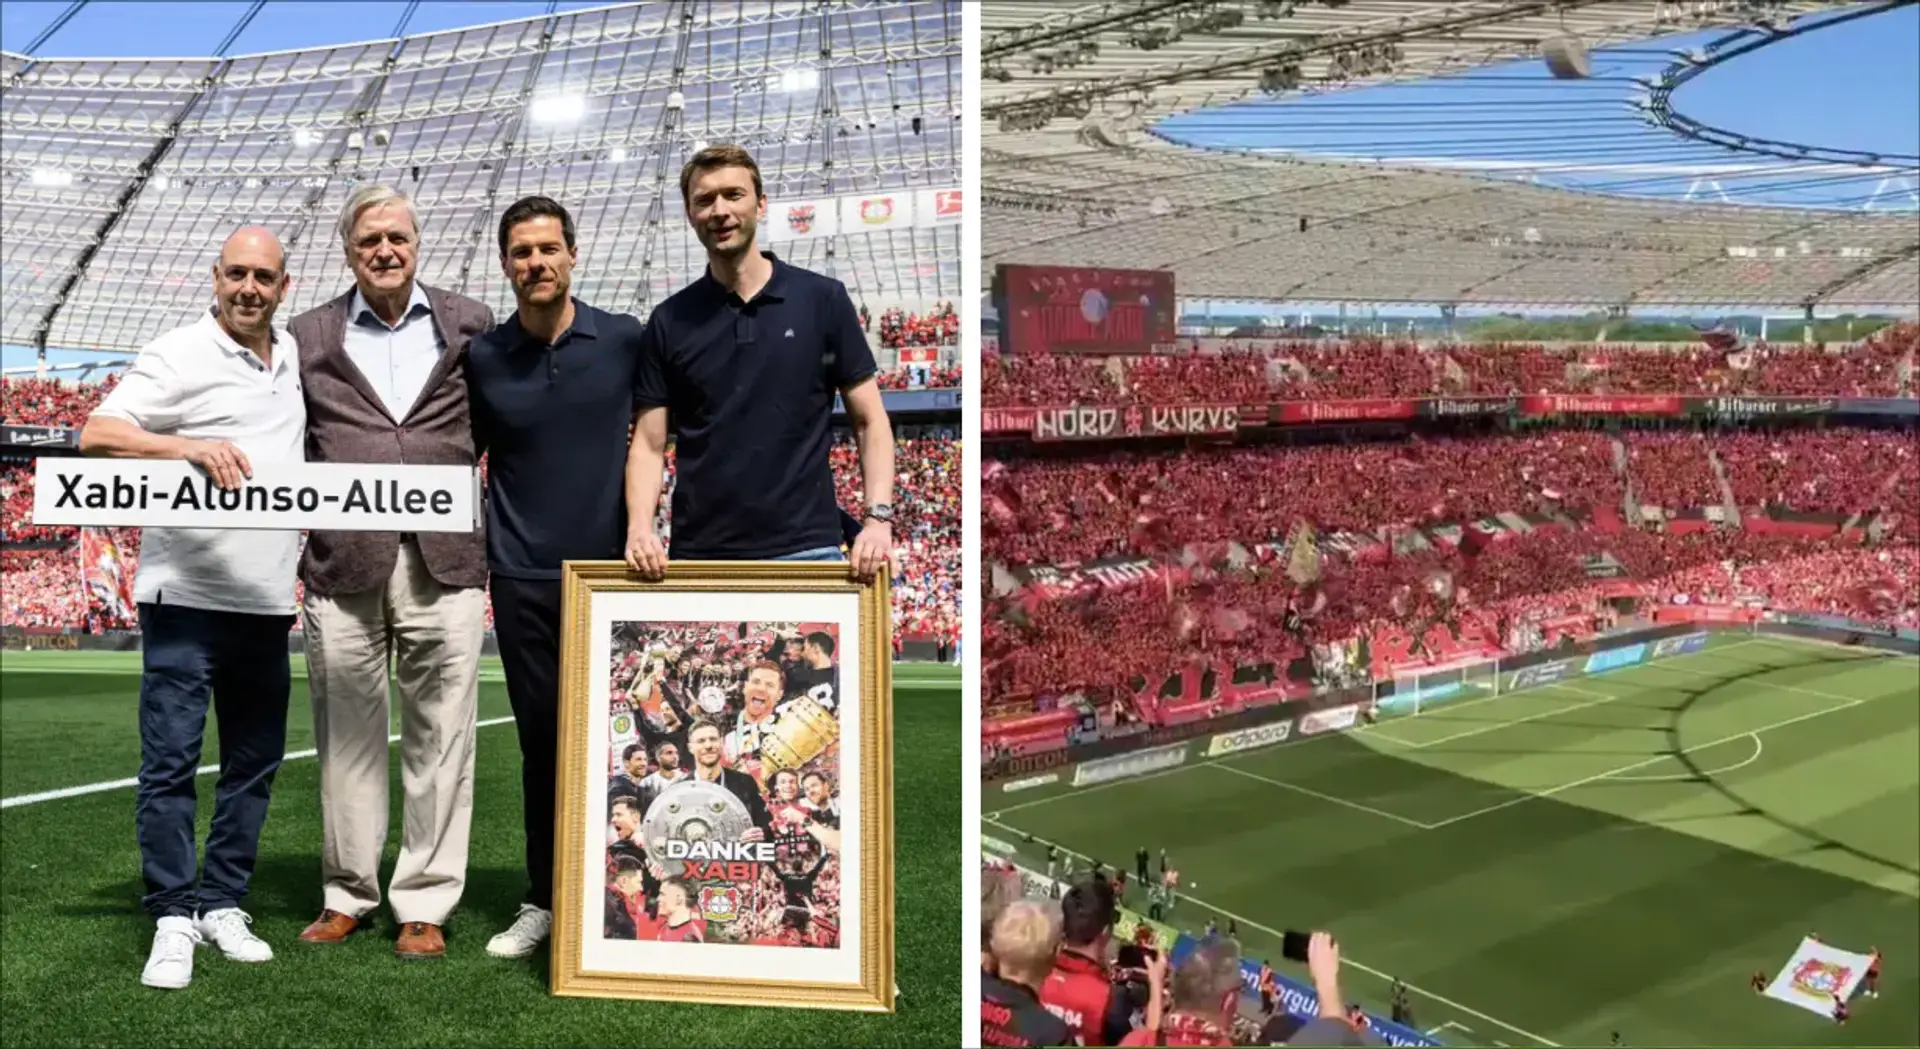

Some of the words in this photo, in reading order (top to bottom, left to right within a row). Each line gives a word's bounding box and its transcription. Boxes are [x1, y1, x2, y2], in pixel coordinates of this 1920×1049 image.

[1036, 407, 1117, 438] NORD
[1152, 406, 1238, 433] KURVE
[54, 473, 454, 515] Xabi-Alonso-Allee
[666, 839, 776, 862] DANKE
[682, 862, 759, 881] XABI
